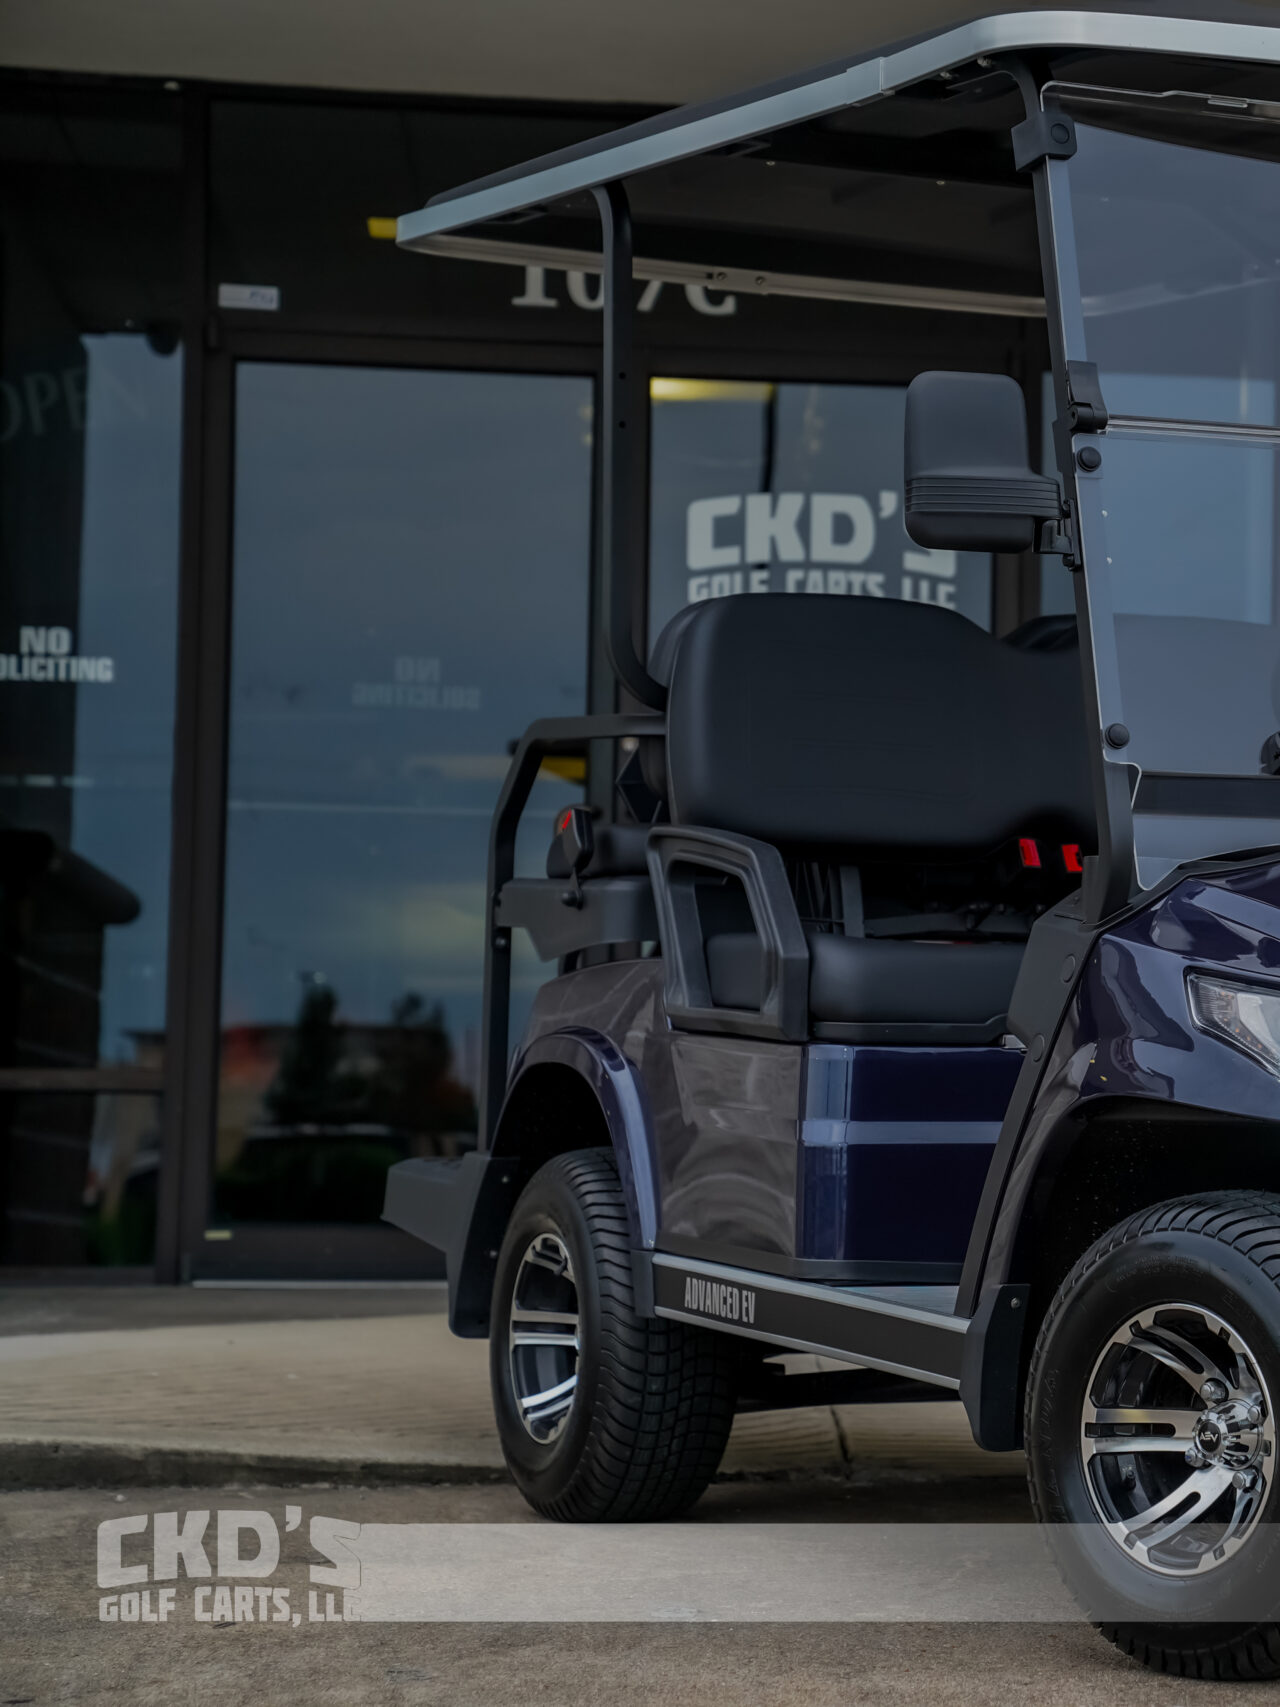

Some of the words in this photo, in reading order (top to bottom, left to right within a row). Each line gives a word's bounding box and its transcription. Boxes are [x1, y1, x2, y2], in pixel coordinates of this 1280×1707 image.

[19, 625, 71, 656] NO
[684, 1276, 740, 1320] ADVANCED
[741, 1289, 756, 1324] EV
